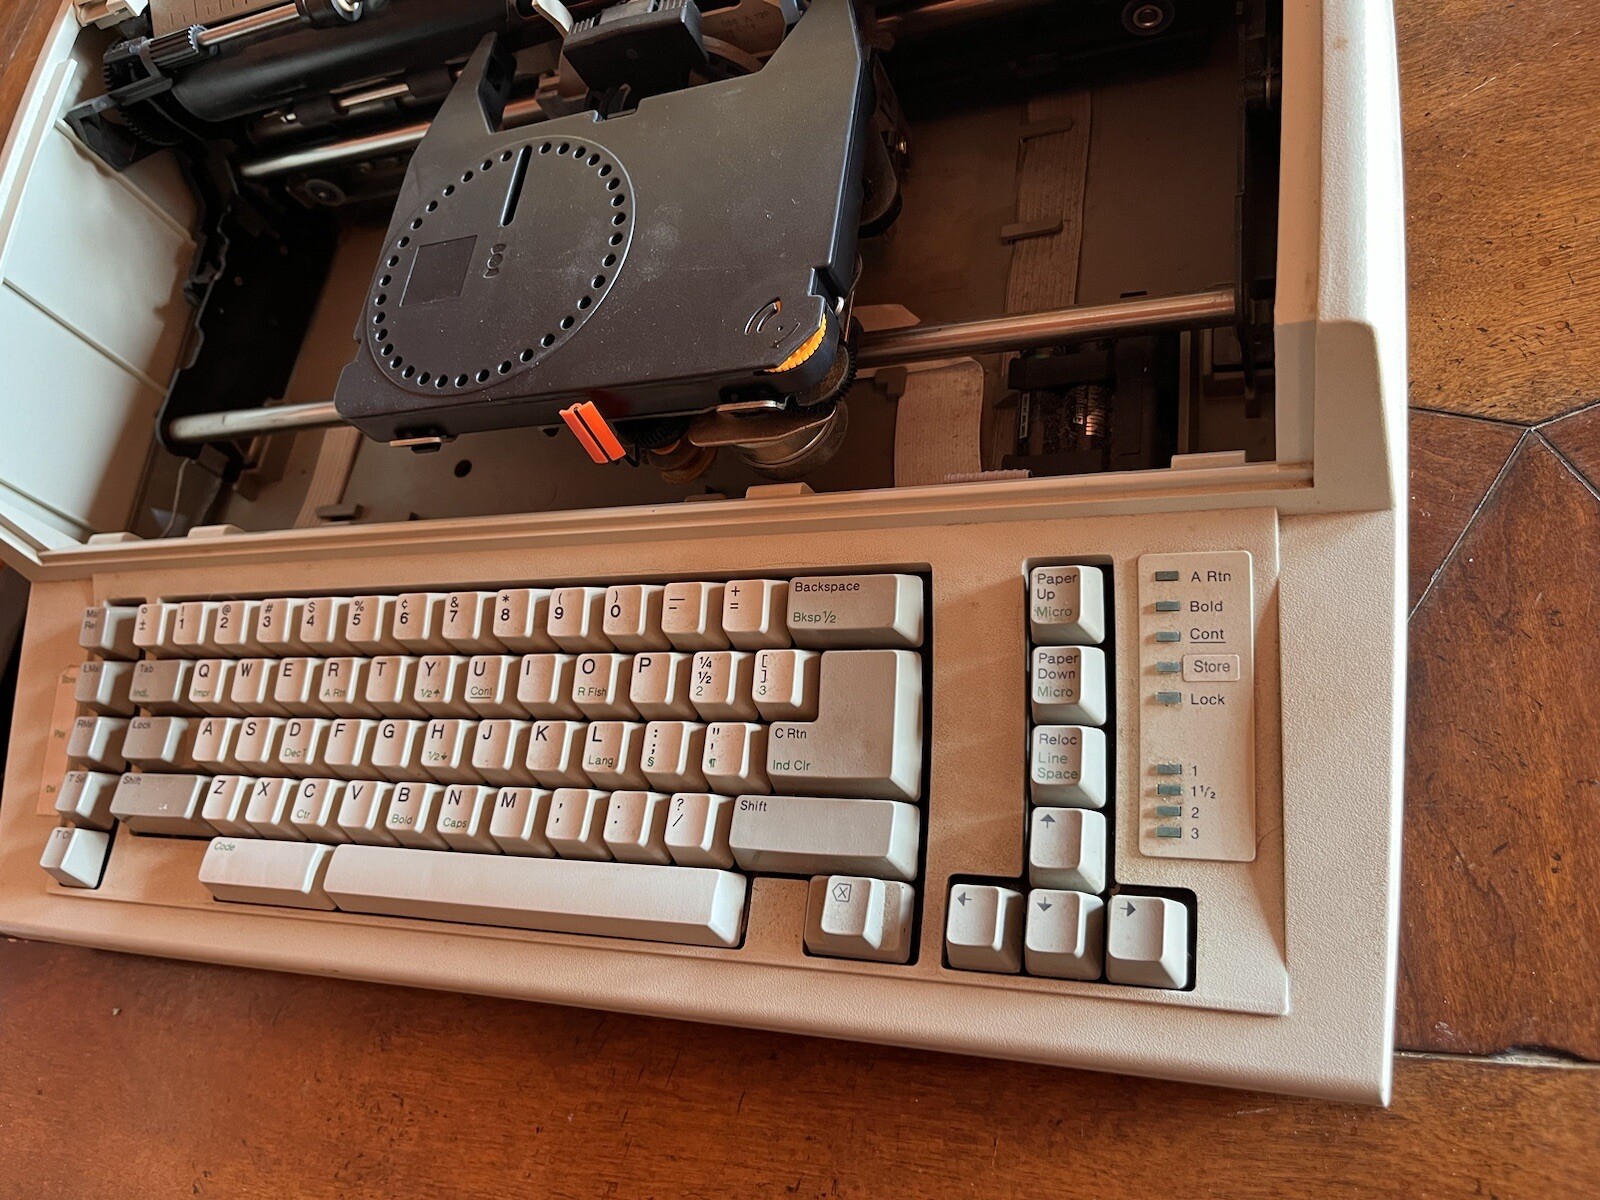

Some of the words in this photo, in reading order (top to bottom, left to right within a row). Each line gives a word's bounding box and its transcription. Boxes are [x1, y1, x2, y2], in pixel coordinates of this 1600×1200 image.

[1037, 573, 1077, 587] Paper
[1190, 571, 1201, 582] A
[1208, 571, 1231, 582] Rtn
[731, 586, 740, 596] +
[795, 581, 860, 593] Backspace
[1037, 589, 1055, 600] Up
[265, 603, 273, 613] #
[354, 600, 364, 612] %
[450, 596, 459, 608] &
[730, 602, 739, 610] =
[1190, 601, 1223, 612] Bold
[222, 604, 231, 615] @
[501, 608, 510, 621] 8
[554, 606, 564, 619] 9
[1036, 606, 1072, 618] Micro
[262, 616, 271, 627] 3
[307, 615, 315, 627] 4
[352, 613, 361, 626] 5
[400, 612, 409, 624] 6
[450, 610, 458, 622] 7
[793, 612, 821, 623] Bksp
[179, 618, 184, 629] 1
[220, 617, 229, 628] 2
[1190, 628, 1224, 640] Cont
[582, 658, 595, 674] O
[638, 657, 651, 673] P
[1038, 653, 1078, 667] Paper
[140, 664, 154, 673] Tab
[198, 664, 210, 678] Q
[241, 663, 253, 677] W
[283, 662, 294, 677] E
[327, 662, 339, 677] R
[377, 662, 387, 676] T
[425, 661, 436, 676] Y
[473, 661, 486, 676] U
[1193, 660, 1231, 673] Store
[1038, 668, 1075, 680] Down
[324, 689, 330, 697] A
[470, 685, 492, 696] Cont
[578, 687, 585, 696] R
[696, 686, 703, 696] 2
[759, 686, 767, 696] 3
[1037, 686, 1073, 698] Micro
[1190, 693, 1225, 705] Lock
[132, 721, 151, 729] Lock
[203, 721, 213, 735] A
[245, 722, 257, 736] S
[289, 722, 301, 736] D
[334, 723, 346, 737] F
[383, 723, 395, 738] G
[431, 724, 444, 739] H
[482, 724, 493, 740] J
[535, 725, 549, 741] K
[592, 726, 603, 742] L
[775, 727, 784, 739] C
[787, 728, 807, 739] Rtn
[1039, 734, 1077, 745] Reloc
[284, 748, 299, 757] Dec
[1038, 752, 1068, 764] Line
[588, 755, 614, 767] Lang
[773, 759, 790, 770] Ind
[793, 760, 811, 771] Clr
[1037, 768, 1078, 780] Space
[1192, 766, 1198, 777] 1
[214, 780, 226, 794] Z
[257, 782, 270, 796] X
[304, 783, 316, 798] C
[352, 785, 363, 800] V
[398, 787, 411, 802] B
[448, 789, 462, 805] N
[500, 792, 517, 808] M
[676, 798, 684, 811] ?
[740, 800, 767, 812] Shift
[1191, 807, 1199, 819] 2
[391, 814, 412, 825] Bold
[443, 817, 467, 828] Caps
[672, 814, 683, 827] /
[1190, 828, 1199, 839] 3
[214, 841, 236, 851] Code
